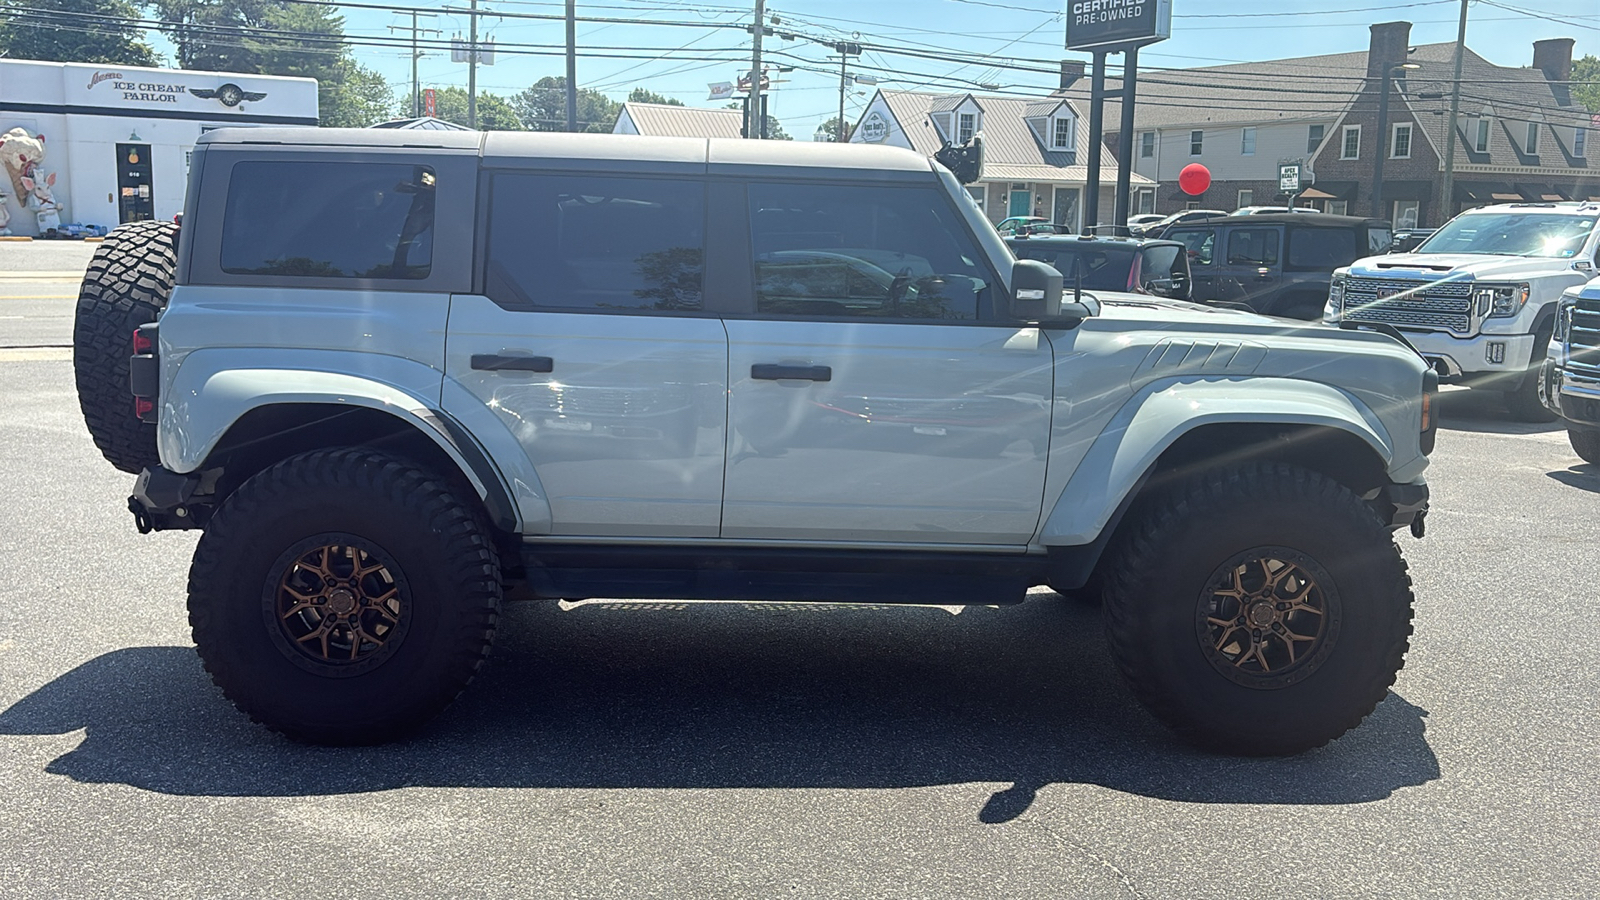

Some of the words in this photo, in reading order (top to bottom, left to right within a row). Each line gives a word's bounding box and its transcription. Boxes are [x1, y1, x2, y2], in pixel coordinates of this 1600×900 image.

[1076, 6, 1142, 25] PRE-OWNED
[113, 82, 135, 90] ICE
[138, 83, 185, 93] CREAM
[124, 92, 176, 102] PARLOR
[1378, 289, 1425, 300] GMC
